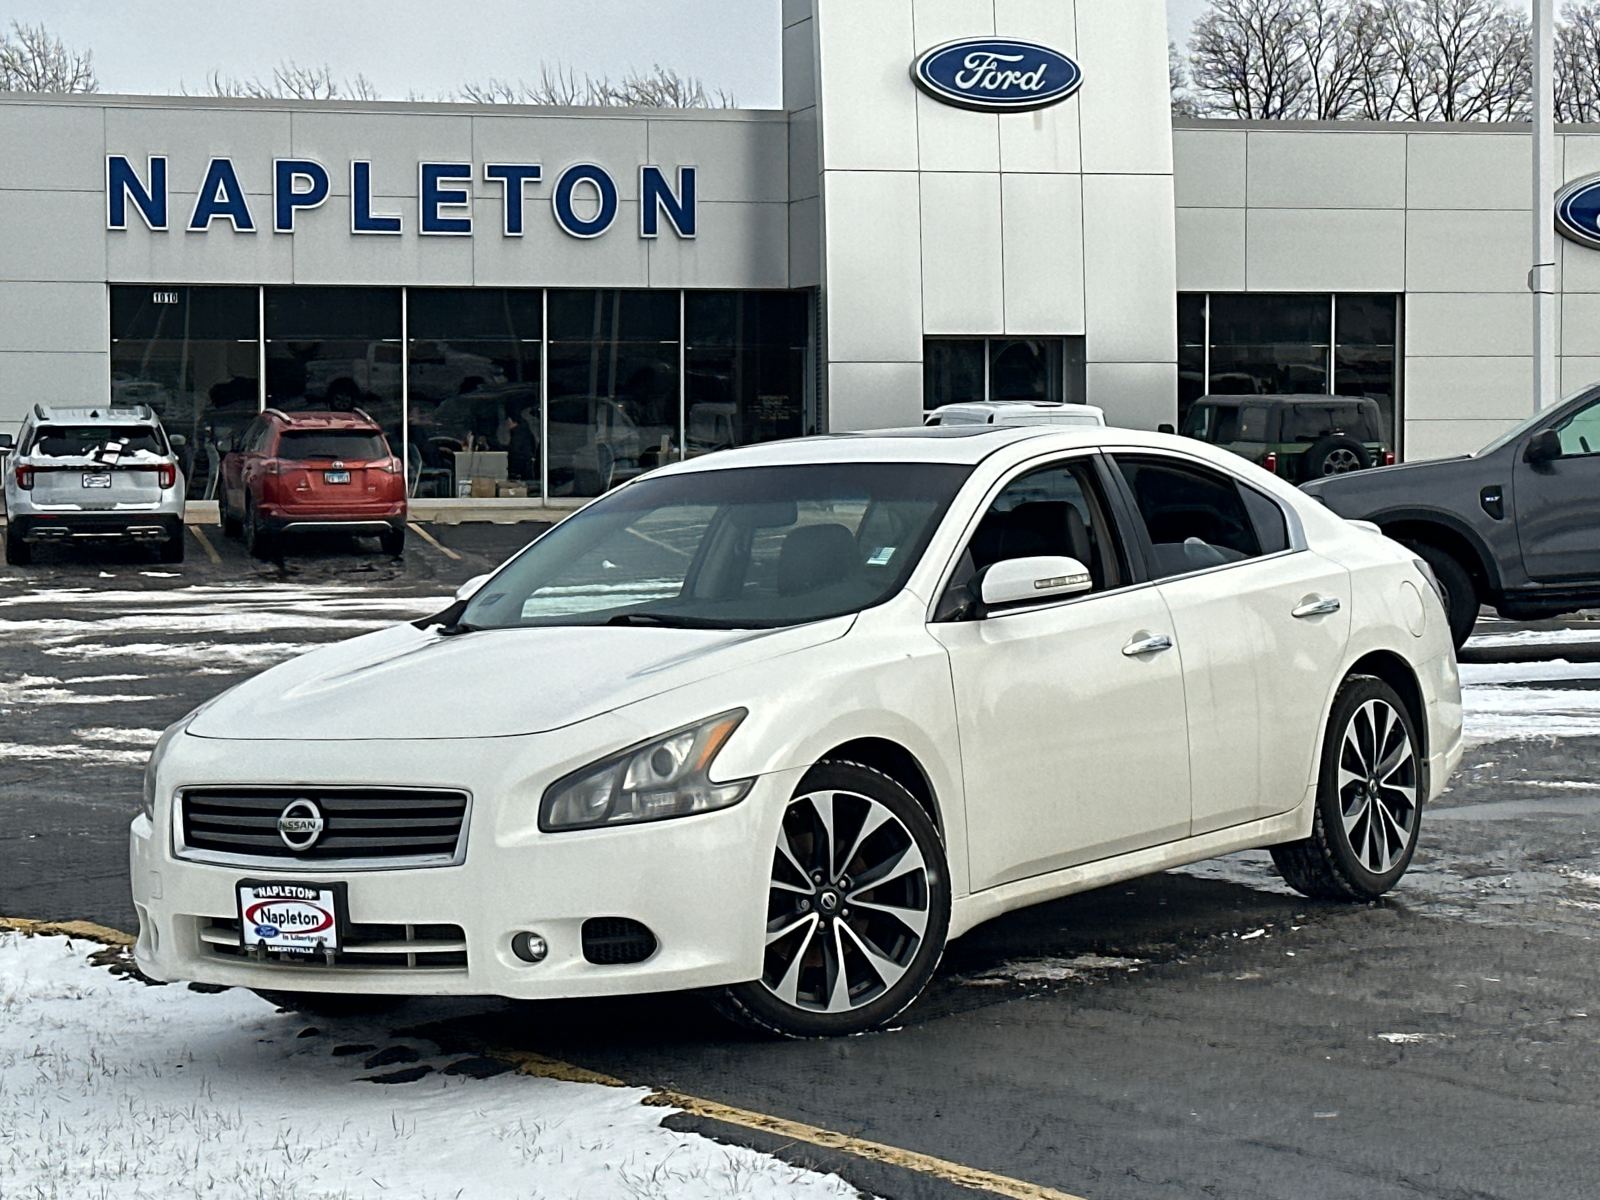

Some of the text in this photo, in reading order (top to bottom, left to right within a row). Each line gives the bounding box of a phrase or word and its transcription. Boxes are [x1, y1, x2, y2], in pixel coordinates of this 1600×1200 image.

[954, 51, 1048, 91] Ford
[105, 154, 696, 239] NAPLETON
[153, 292, 178, 303] 1010
[279, 820, 316, 830] NISSAN
[258, 885, 314, 899] NAPLETON
[260, 908, 319, 928] Napleton
